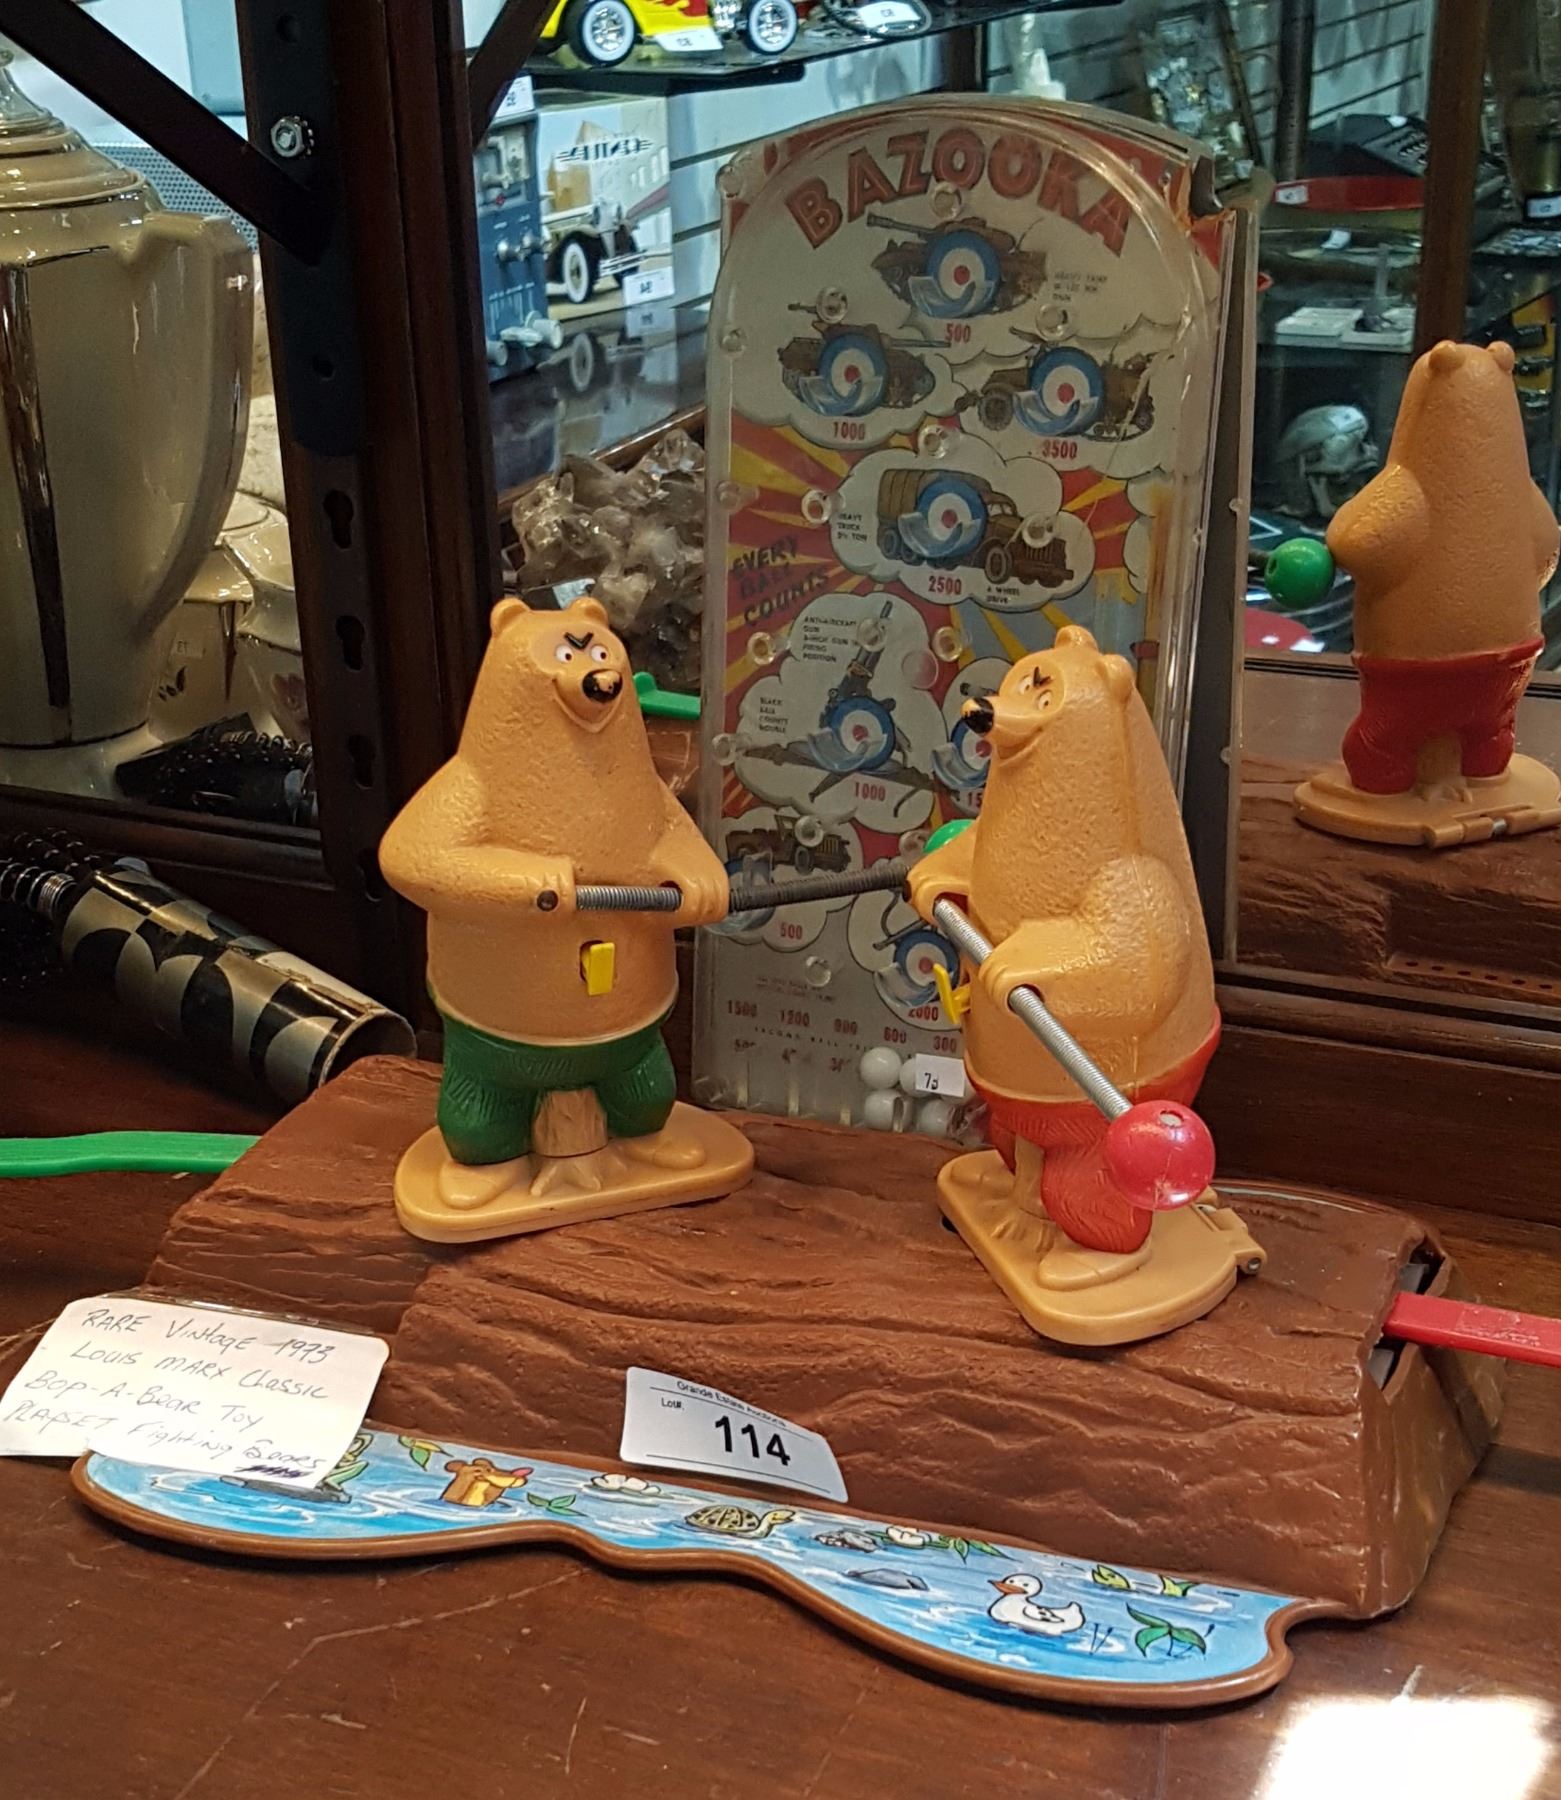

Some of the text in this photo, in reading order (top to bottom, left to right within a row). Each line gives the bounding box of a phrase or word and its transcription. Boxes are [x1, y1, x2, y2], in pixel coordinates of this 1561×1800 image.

[785, 127, 1131, 257] BAZOOKA
[944, 322, 971, 344] 500
[833, 421, 866, 441] 1000
[1042, 439, 1078, 460] 3500
[733, 535, 797, 579] EVERY
[928, 575, 962, 595] 2500
[744, 566, 828, 627] COUNTS
[855, 782, 886, 801] 1000
[780, 921, 803, 940] 500
[908, 1006, 939, 1021] 2000
[728, 1000, 758, 1018] 1500
[780, 1009, 810, 1027] 1200
[883, 1026, 907, 1044] 600
[934, 1036, 957, 1054] 300
[82, 1308, 152, 1333] RARE
[266, 1337, 337, 1364] 1973
[71, 1341, 138, 1366] LOUIS
[677, 1381, 713, 1399] Grande
[715, 1415, 791, 1467] 114
